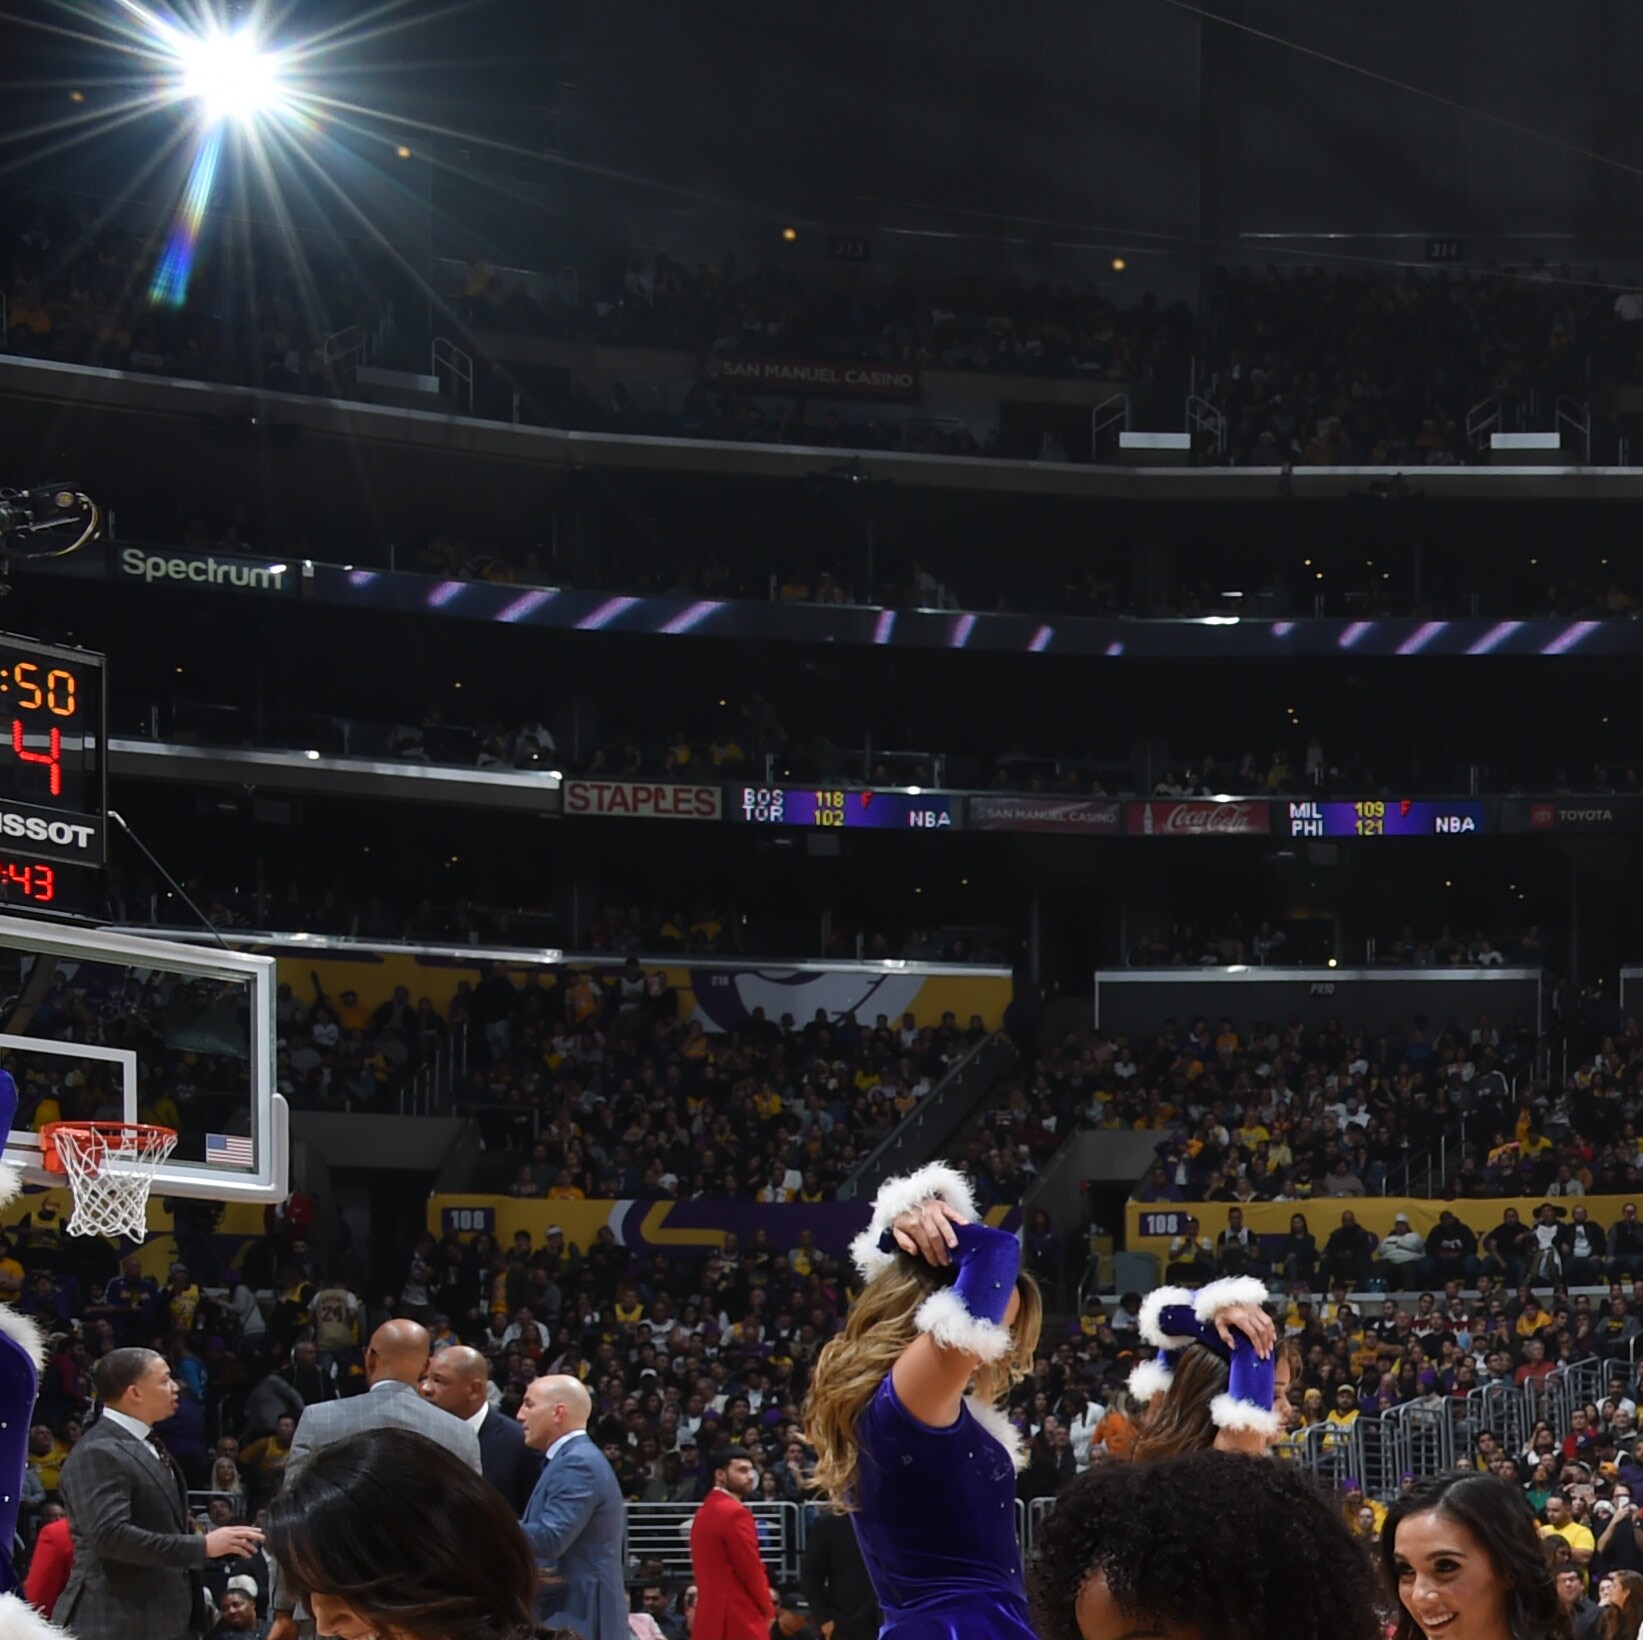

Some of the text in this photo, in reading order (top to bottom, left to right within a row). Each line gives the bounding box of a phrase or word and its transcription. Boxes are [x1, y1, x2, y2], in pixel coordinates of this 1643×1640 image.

[723, 361, 913, 387] SAN MANUEL CASINO
[122, 548, 282, 590] Spectrum
[567, 784, 716, 816] STAPLES
[743, 787, 873, 809] BOS 118 F
[743, 804, 844, 827] TOR 102
[909, 810, 951, 828] NBA
[987, 807, 1011, 819] SAN
[1070, 812, 1116, 824] CASINO
[1289, 800, 1411, 819] MIL 109 F
[1559, 809, 1613, 821] TOYOTA
[1291, 819, 1385, 837] PHI 121
[1435, 816, 1475, 834] NBA
[450, 1210, 485, 1230] 108
[1146, 1214, 1178, 1234] 108
[321, 1306, 344, 1323] 24
